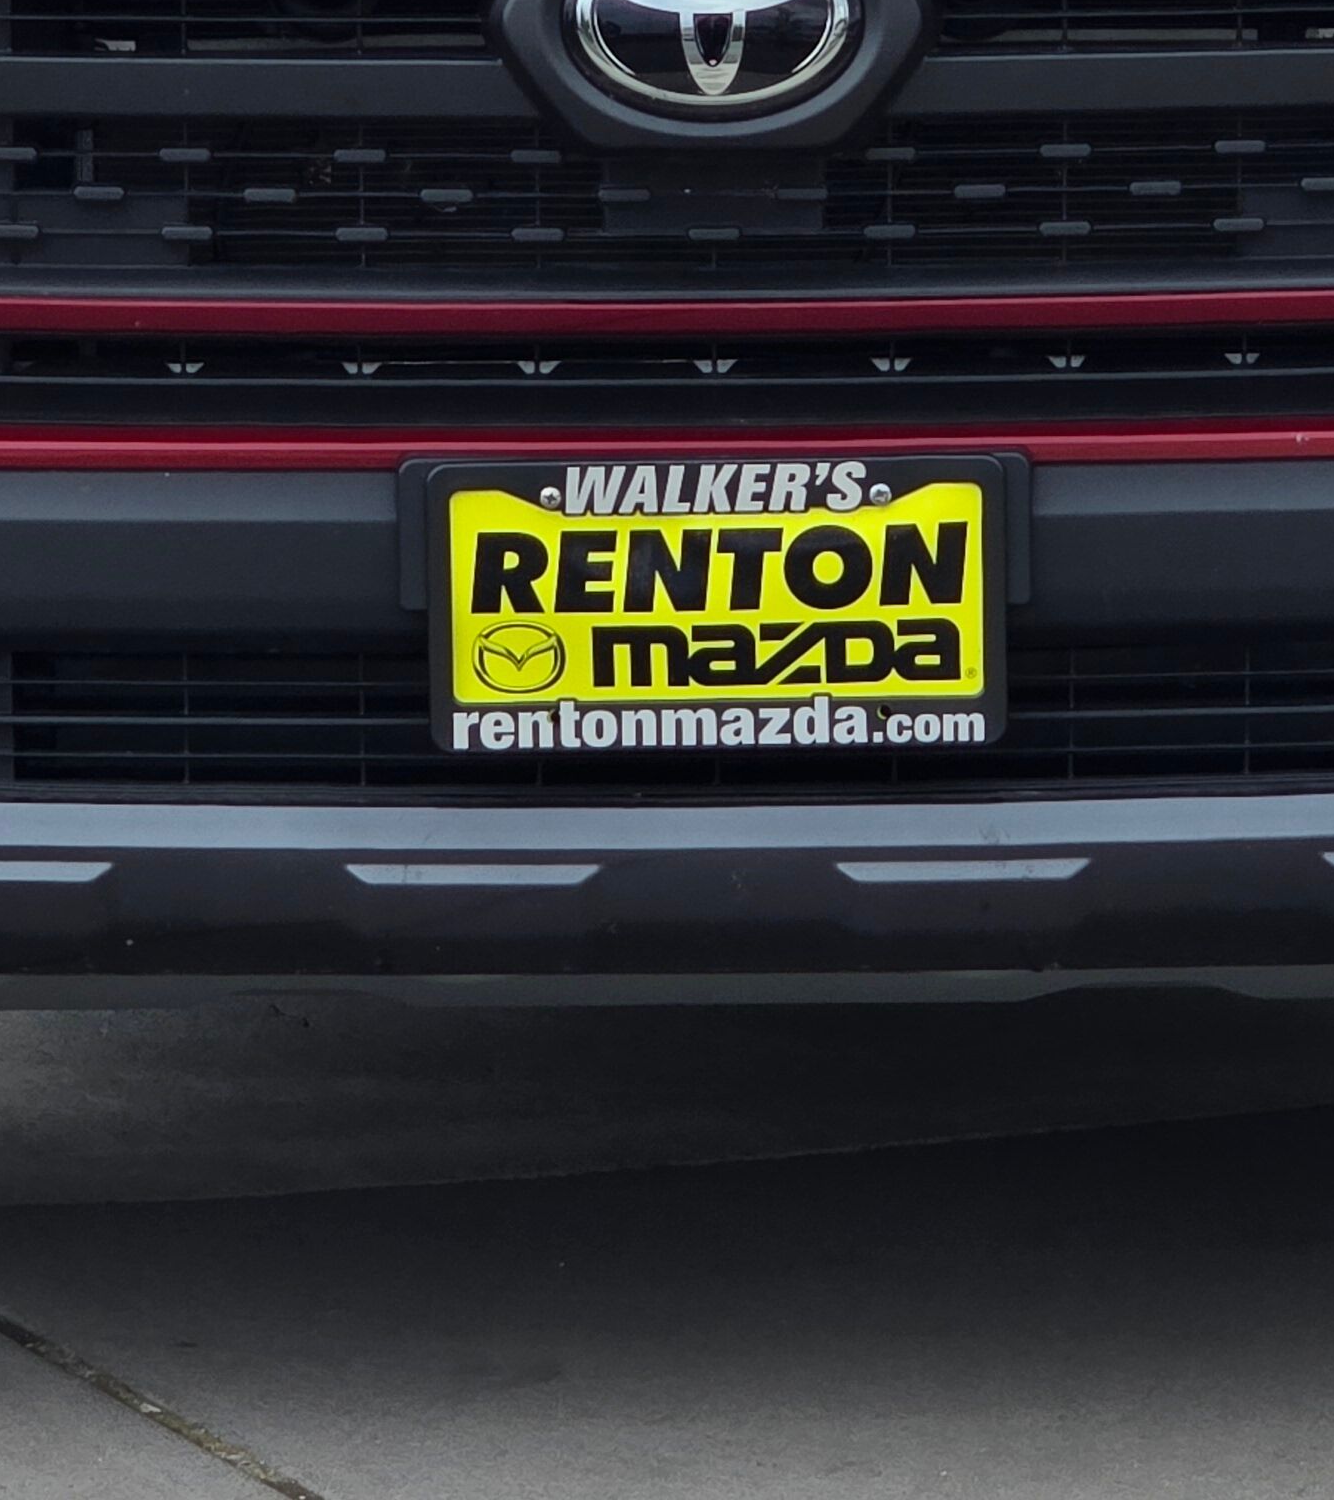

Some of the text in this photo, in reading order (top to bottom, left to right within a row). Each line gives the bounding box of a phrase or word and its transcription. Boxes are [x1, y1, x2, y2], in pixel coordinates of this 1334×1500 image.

[565, 461, 867, 514] WALKER'S
[471, 521, 968, 614] RENTON
[453, 696, 986, 749] rentonmazda.com
